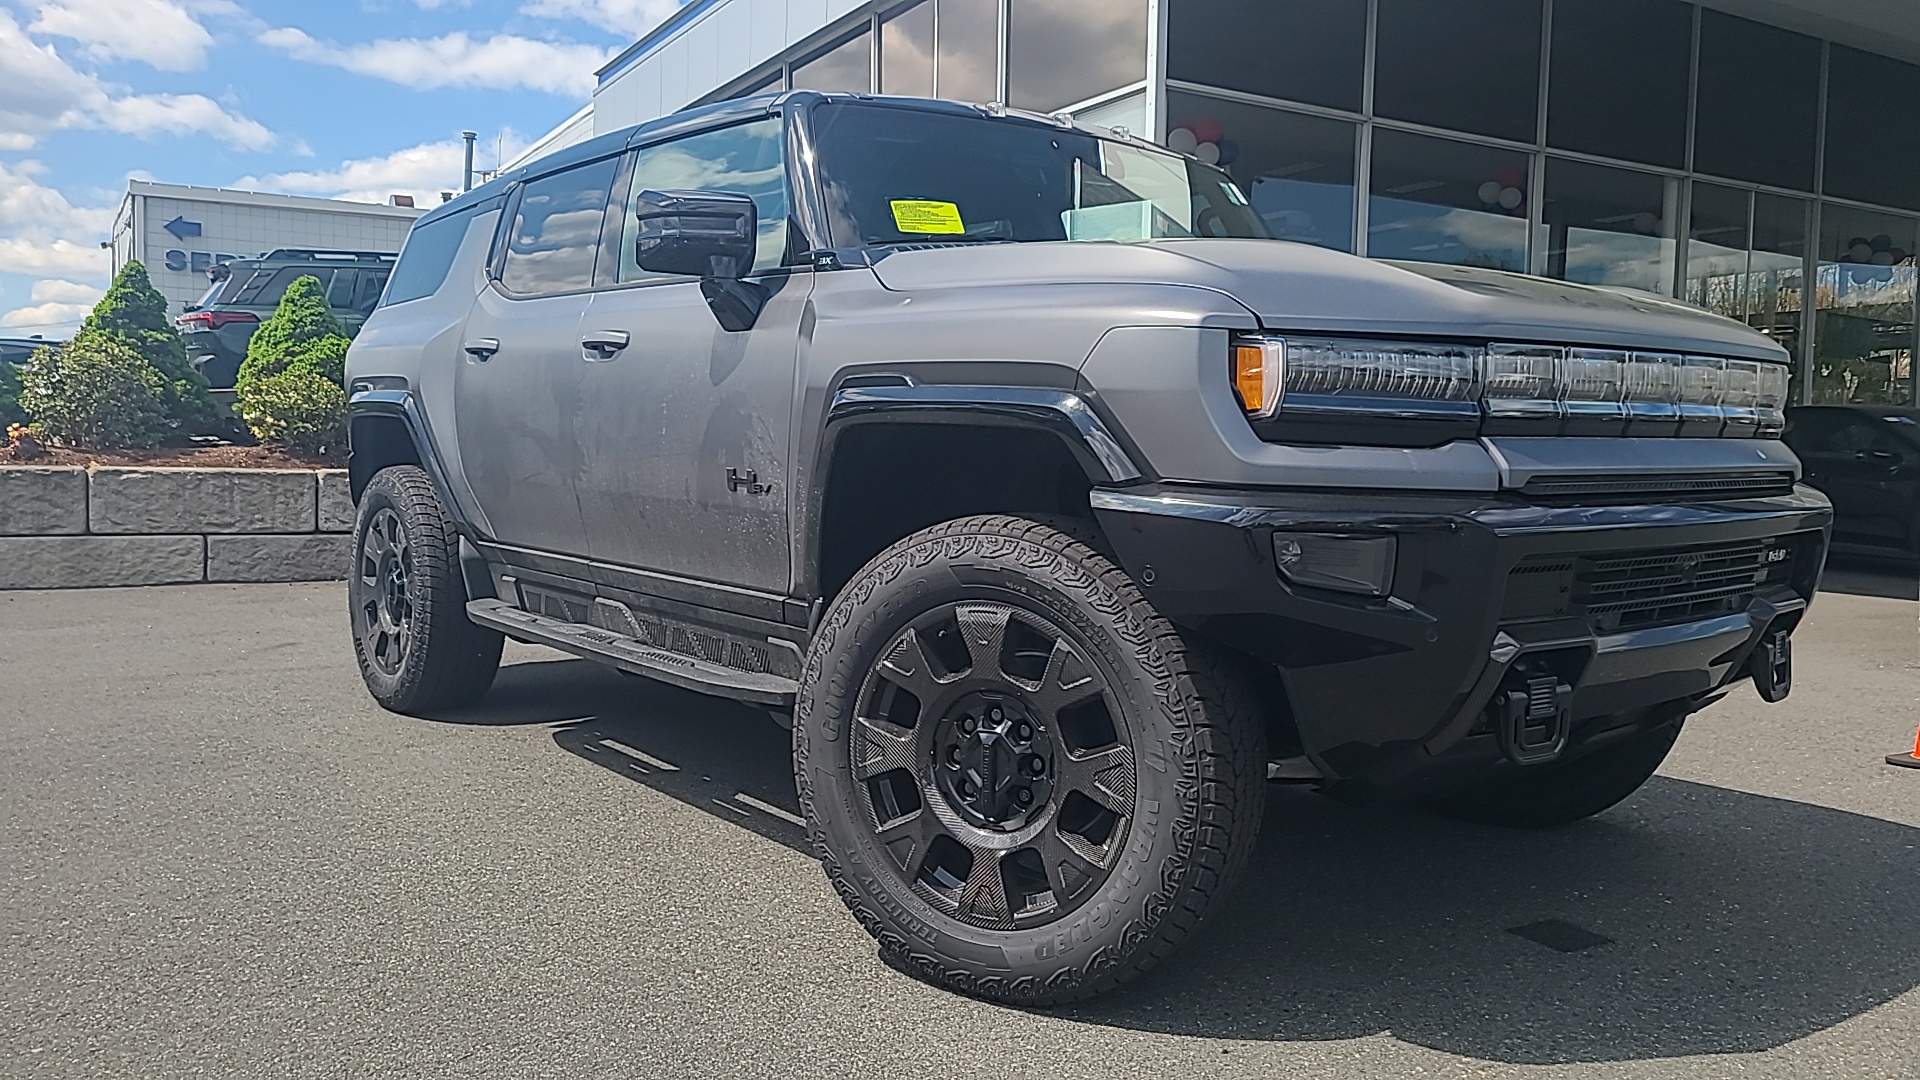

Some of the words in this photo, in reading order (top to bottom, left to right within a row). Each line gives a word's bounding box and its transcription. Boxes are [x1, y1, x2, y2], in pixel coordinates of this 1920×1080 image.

[845, 848, 863, 865] AT
[1034, 799, 1160, 961] WRANGLER
[861, 875, 938, 944] TERRITORY
